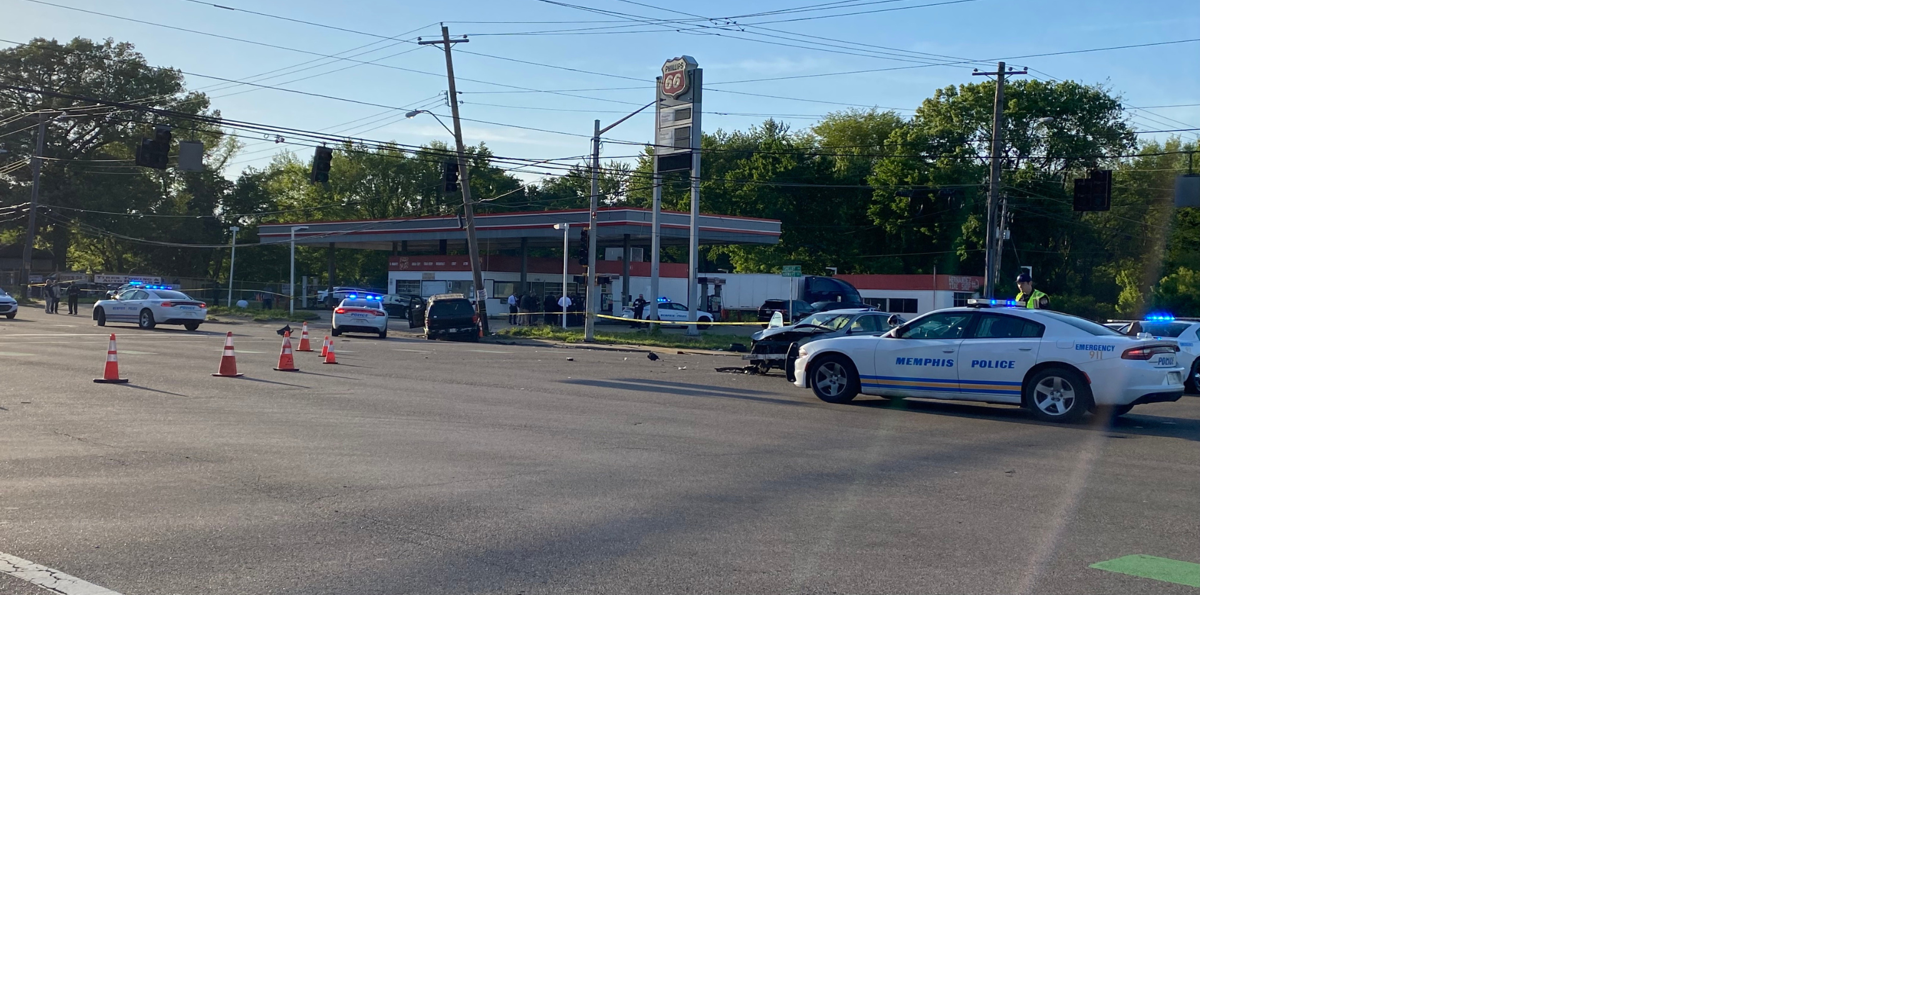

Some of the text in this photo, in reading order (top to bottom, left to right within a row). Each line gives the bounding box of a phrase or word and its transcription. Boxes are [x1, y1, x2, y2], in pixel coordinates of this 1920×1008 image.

[665, 73, 681, 89] 66
[1075, 343, 1116, 352] EMERGENCY
[1089, 351, 1103, 360] 911
[895, 357, 1016, 369] MEMPHIS POLICE
